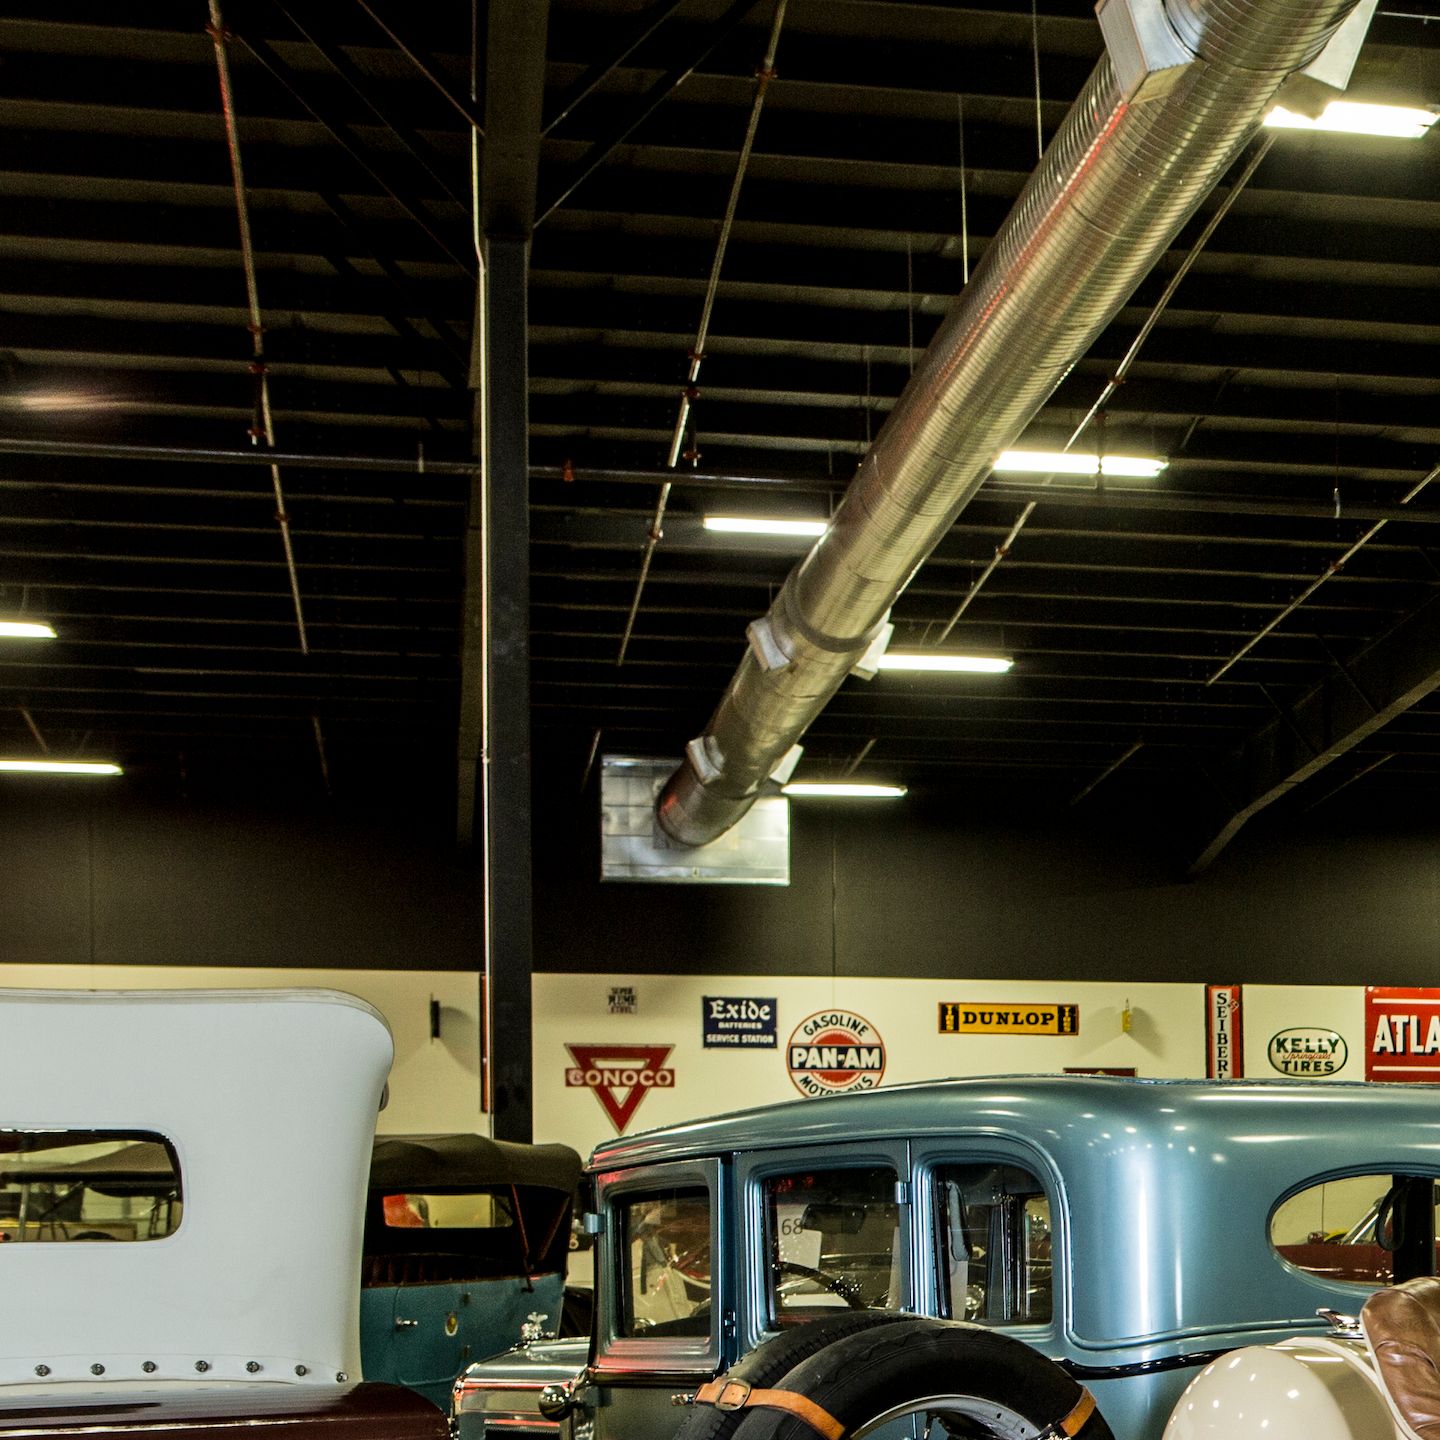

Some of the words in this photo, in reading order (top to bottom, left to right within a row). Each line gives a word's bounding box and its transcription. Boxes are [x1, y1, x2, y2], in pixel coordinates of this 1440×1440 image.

[710, 1000, 771, 1020] Exide
[962, 1011, 1056, 1026] DUNLOP
[803, 1014, 869, 1038] GASOLINE
[706, 1034, 740, 1044] SERVICE
[741, 1034, 774, 1044] STATION
[1275, 1037, 1340, 1053] KELLY
[791, 1047, 881, 1070] PAN-AM
[1281, 1061, 1335, 1072] TIRES
[568, 1069, 673, 1086] CONOCO
[781, 1218, 803, 1236] 68
